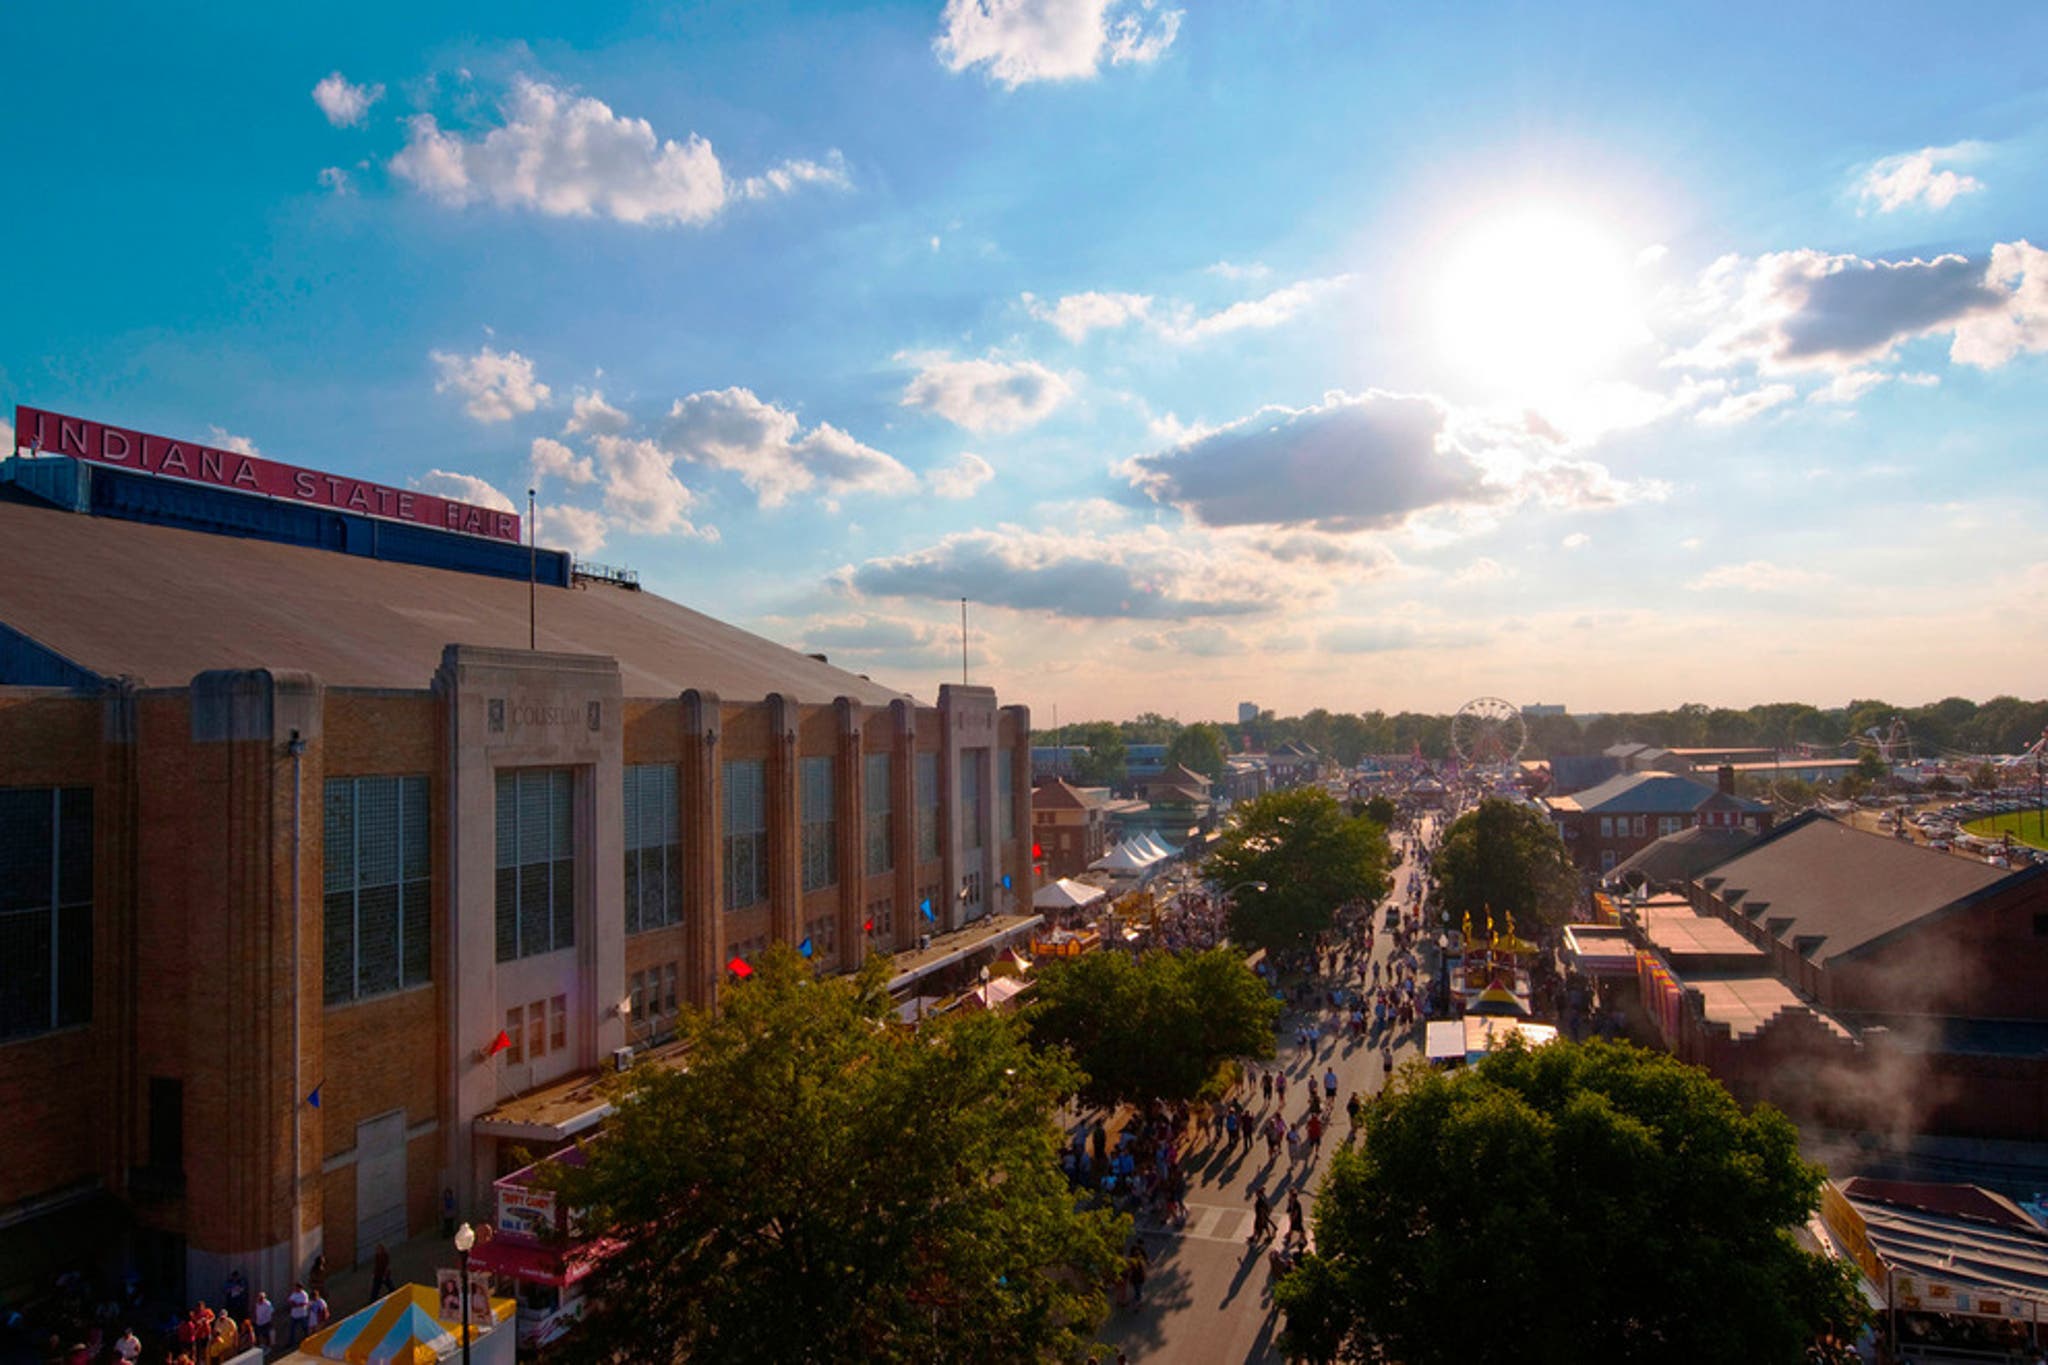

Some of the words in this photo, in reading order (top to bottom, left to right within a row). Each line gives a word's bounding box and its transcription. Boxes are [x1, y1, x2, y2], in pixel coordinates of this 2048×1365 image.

[36, 413, 259, 487] INDIANA
[294, 472, 415, 518] STATE
[447, 502, 513, 538] FAIR
[512, 705, 581, 727] COLISEUM
